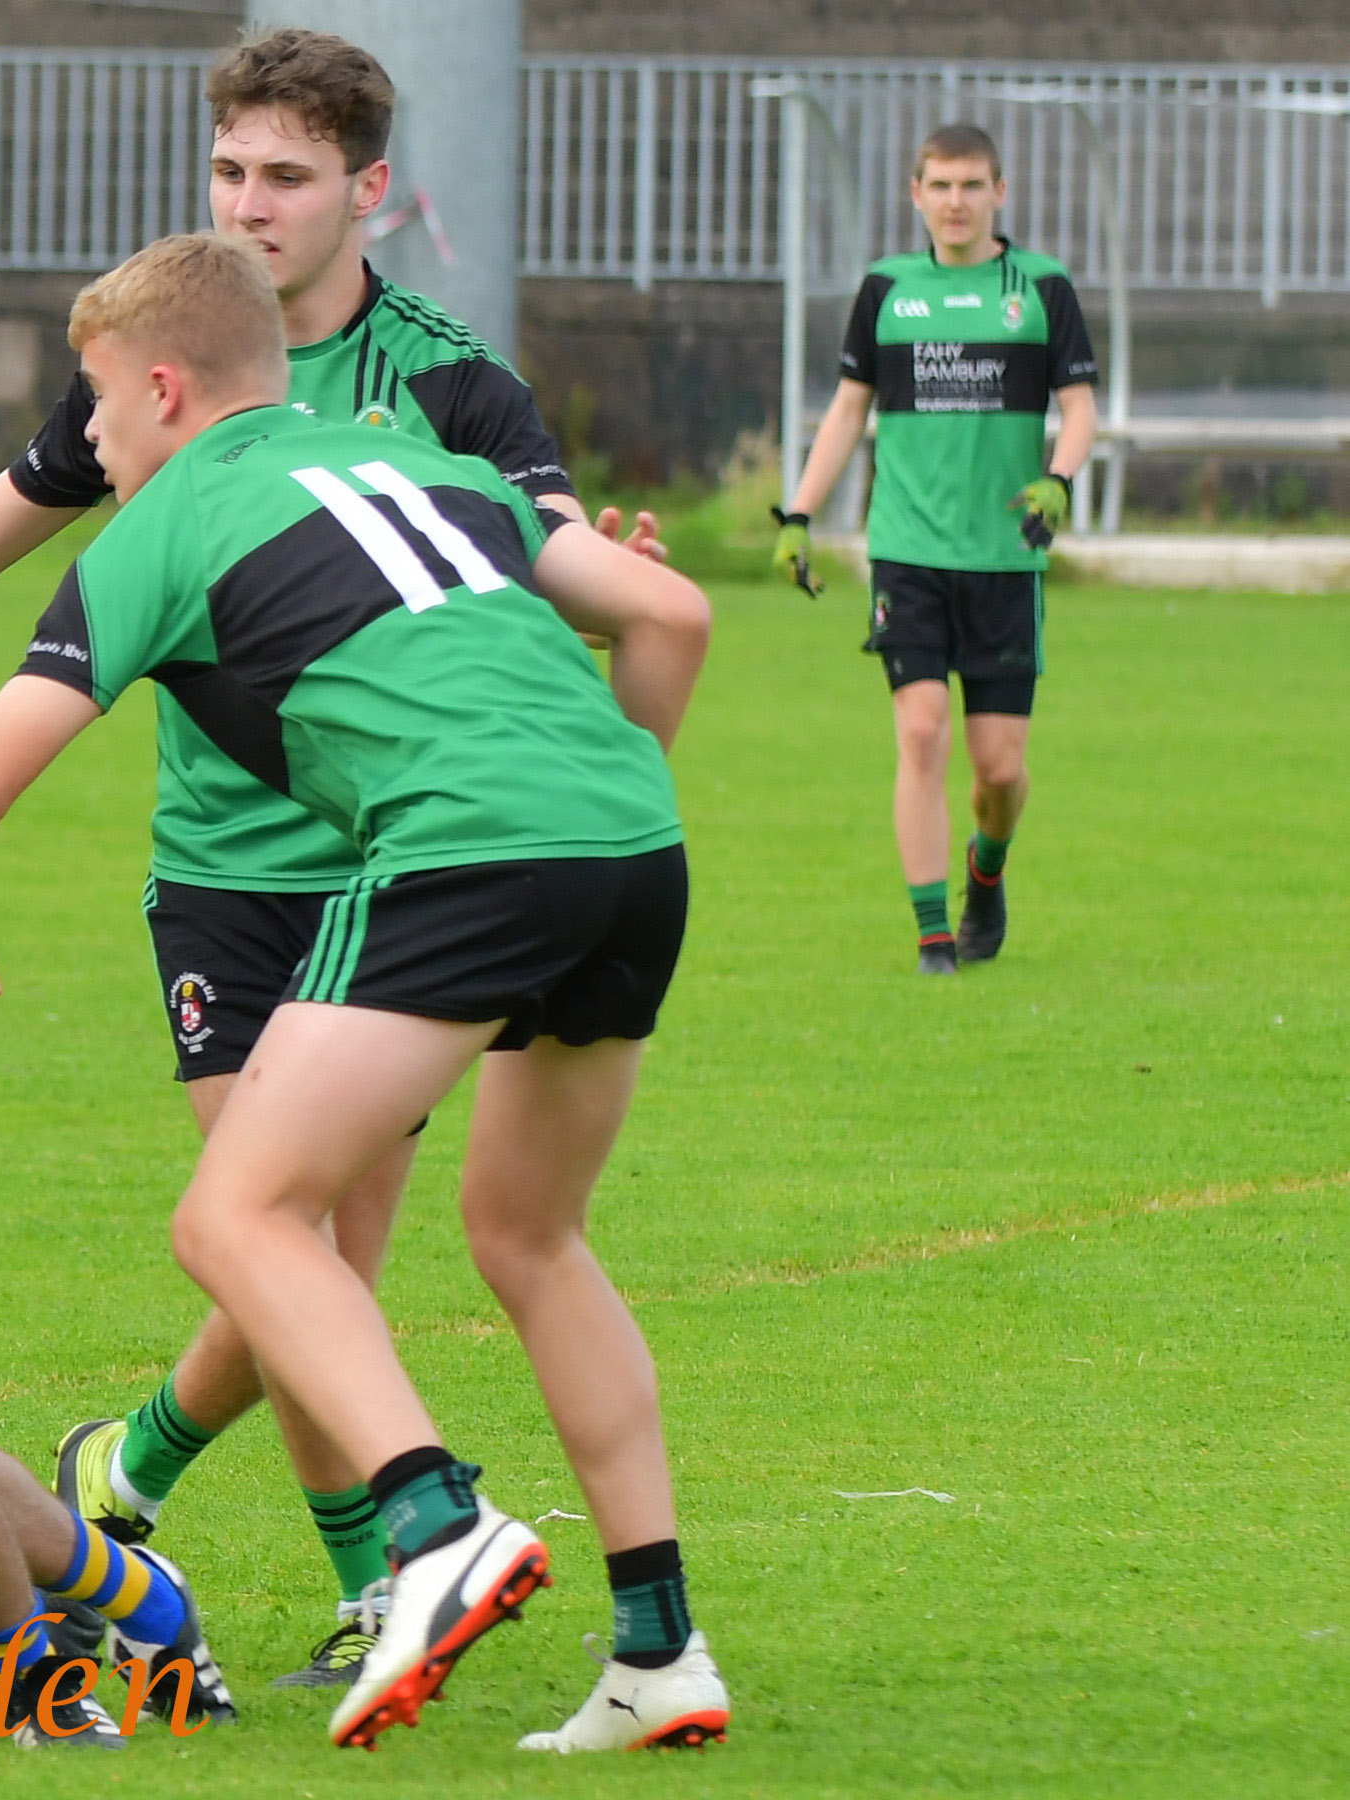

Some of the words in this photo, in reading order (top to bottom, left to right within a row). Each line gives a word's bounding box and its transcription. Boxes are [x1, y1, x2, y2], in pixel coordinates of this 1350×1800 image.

[913, 341, 965, 360] FAHY
[913, 359, 1006, 382] BAMBURY
[289, 461, 507, 614] 11
